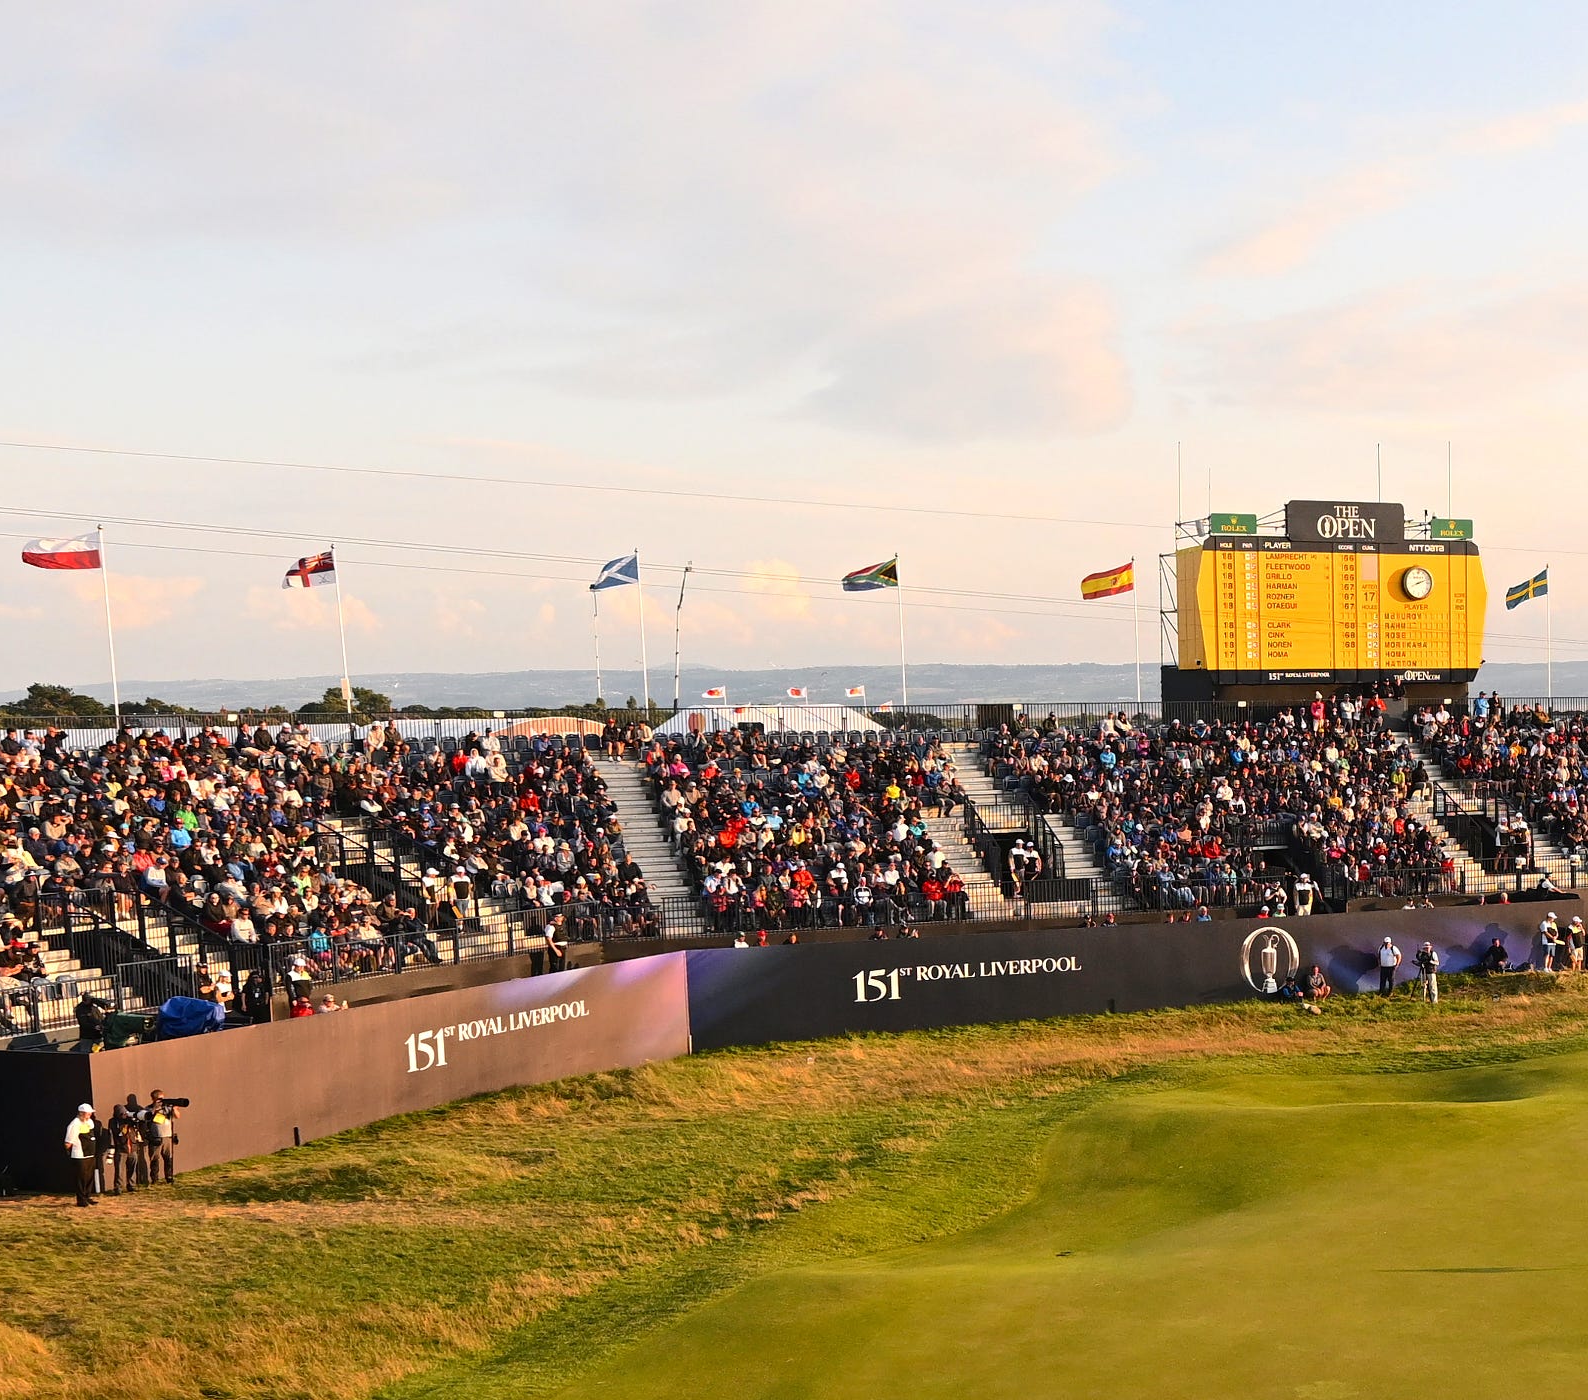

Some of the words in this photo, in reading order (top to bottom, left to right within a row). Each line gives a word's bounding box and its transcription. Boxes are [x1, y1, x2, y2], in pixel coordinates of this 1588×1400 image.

[1334, 506, 1359, 517] THE
[1317, 515, 1376, 538] OPEN
[1364, 592, 1376, 602] 17
[916, 963, 976, 981] ROYAL
[980, 956, 1082, 977] LIVERPOOL
[458, 1016, 507, 1041] ROYAL
[509, 1000, 590, 1031] LIVERPOOL
